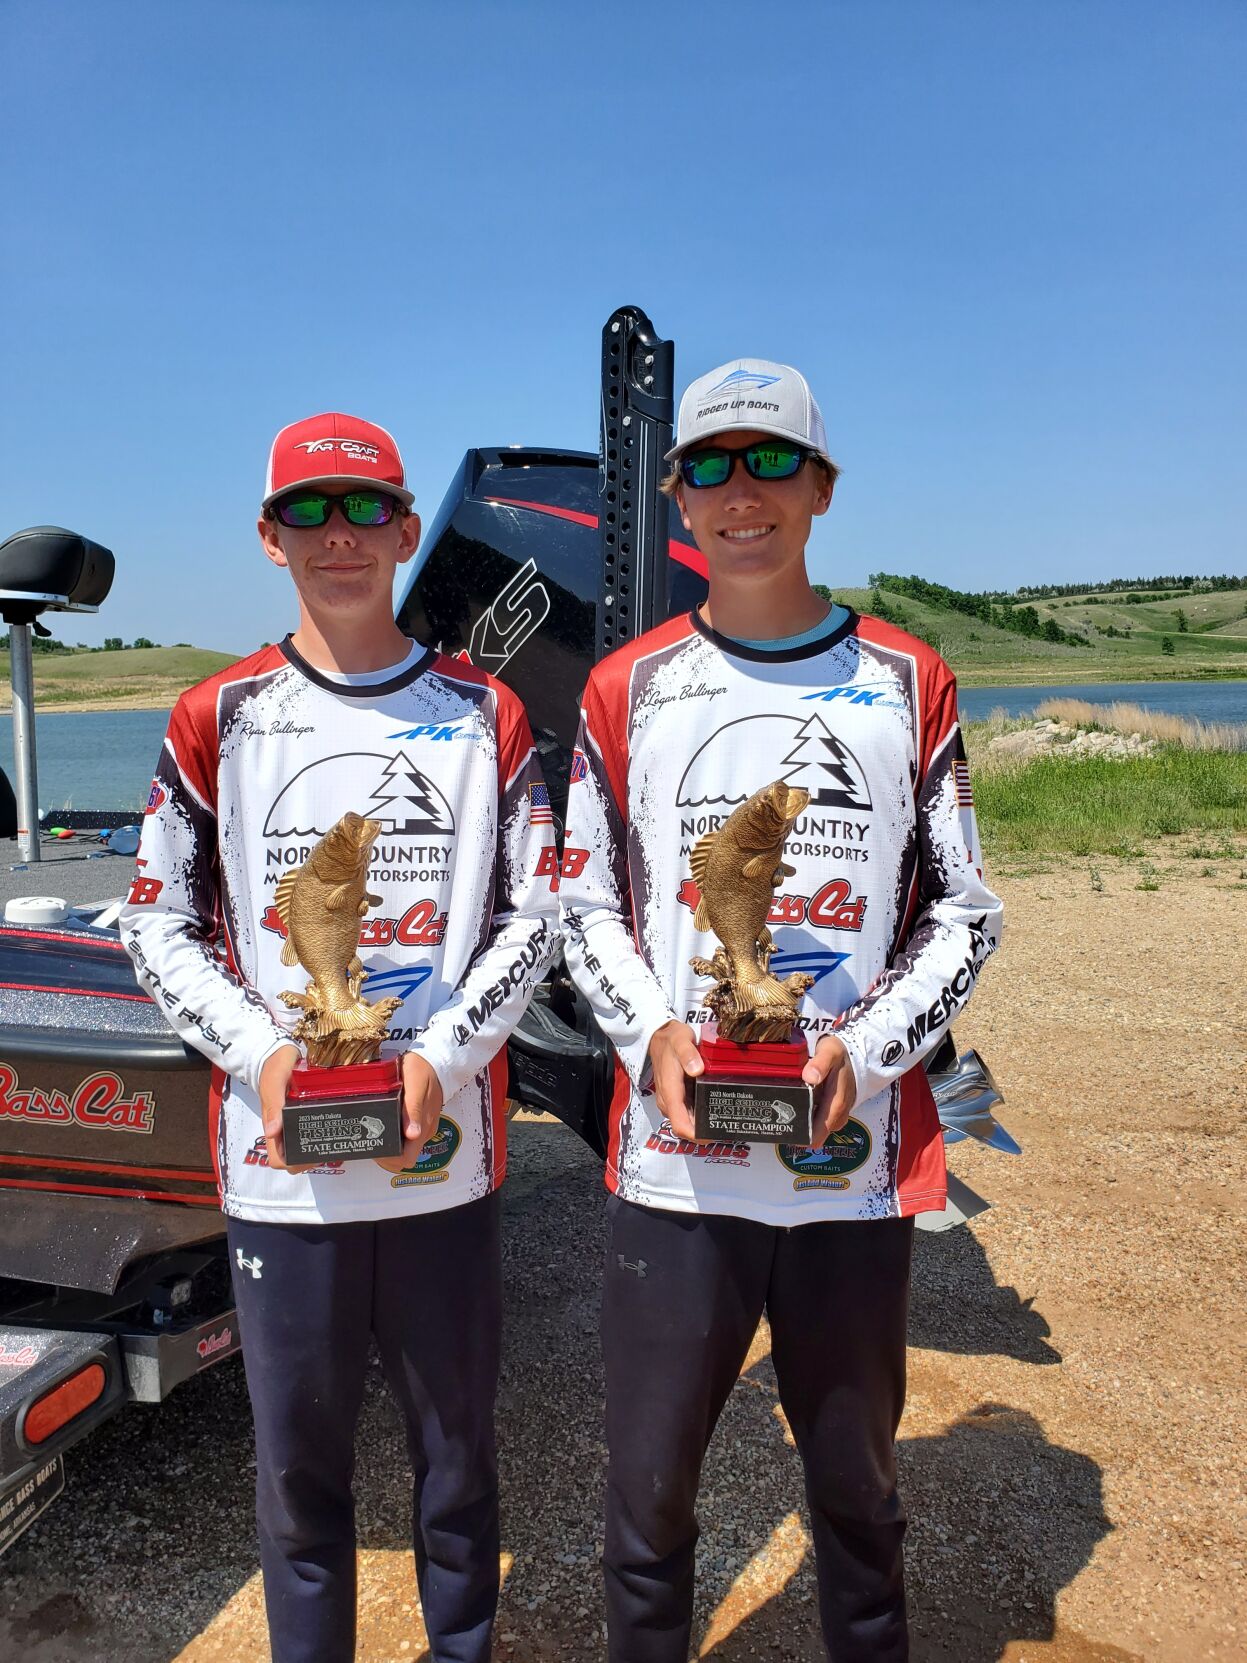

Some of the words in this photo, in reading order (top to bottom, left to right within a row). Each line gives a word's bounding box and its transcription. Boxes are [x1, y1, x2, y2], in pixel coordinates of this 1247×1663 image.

[730, 401, 745, 409] UP
[747, 400, 780, 412] BOATS
[347, 452, 378, 464] BOATS
[644, 690, 677, 710] Logan
[679, 683, 728, 701] Bullinger
[240, 721, 266, 740] Ryan
[269, 720, 315, 739] Bullinger
[793, 816, 870, 841] UNTRY
[783, 842, 869, 862] TORSPORTS
[806, 878, 868, 932] Cat
[394, 898, 449, 947] Cat
[599, 974, 637, 1026] RUSH
[177, 1005, 233, 1055] RUSH
[72, 1070, 156, 1134] Cat
[709, 1105, 772, 1118] FISHING
[735, 1099, 771, 1107] SCHOOL
[299, 1121, 323, 1129] HIGH
[324, 1118, 361, 1127] SCHOOL
[299, 1125, 361, 1139] FISHING
[709, 1120, 740, 1130] STATE
[742, 1122, 793, 1133] CHAMPION
[301, 1143, 331, 1153] STATE
[333, 1138, 384, 1150] CHAMPION
[16, 1479, 35, 1505] BASS
[36, 1457, 57, 1487] BOATS
